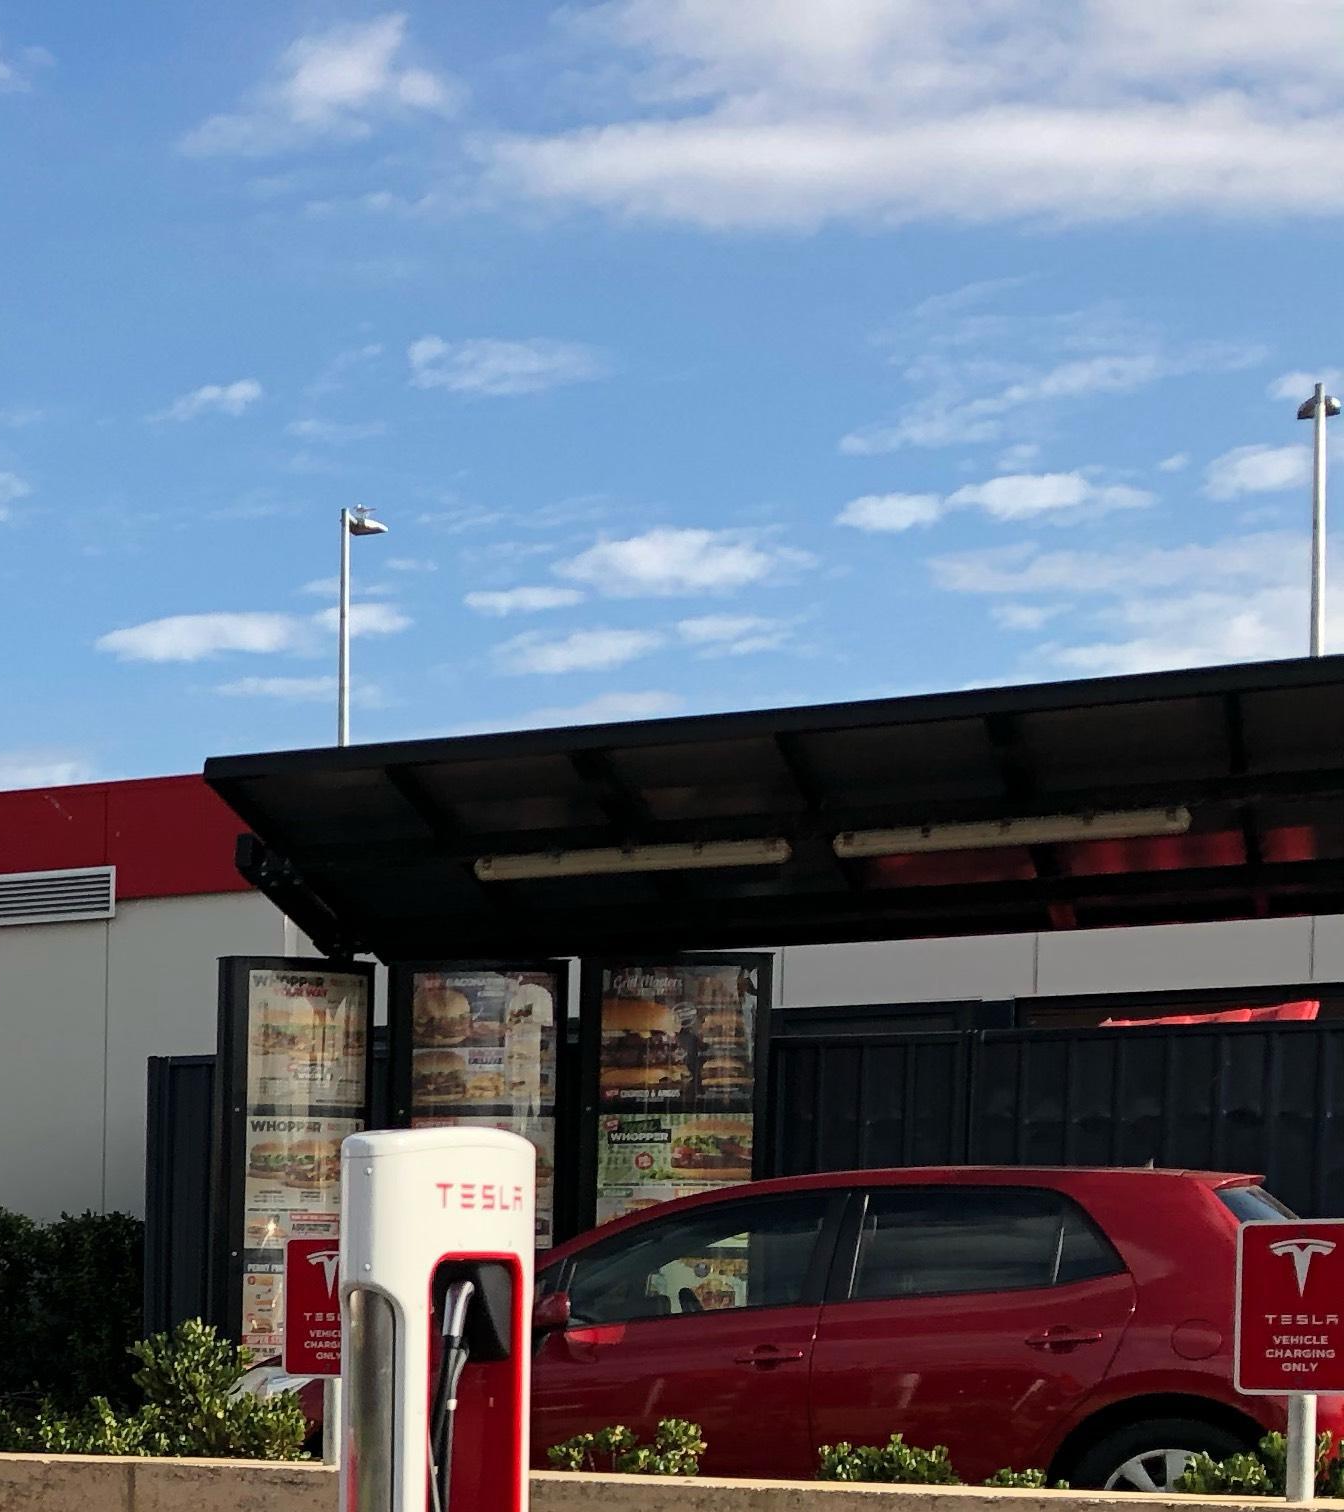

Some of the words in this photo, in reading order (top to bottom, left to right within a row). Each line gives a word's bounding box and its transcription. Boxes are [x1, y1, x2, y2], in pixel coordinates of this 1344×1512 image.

[611, 1132, 669, 1142] WHOPPER
[435, 1183, 523, 1212] TESLA
[1264, 1314, 1339, 1325] TESLA
[1272, 1335, 1329, 1345] VEHICLE
[1265, 1349, 1336, 1359] CHARGING
[1281, 1362, 1319, 1372] ONLY
